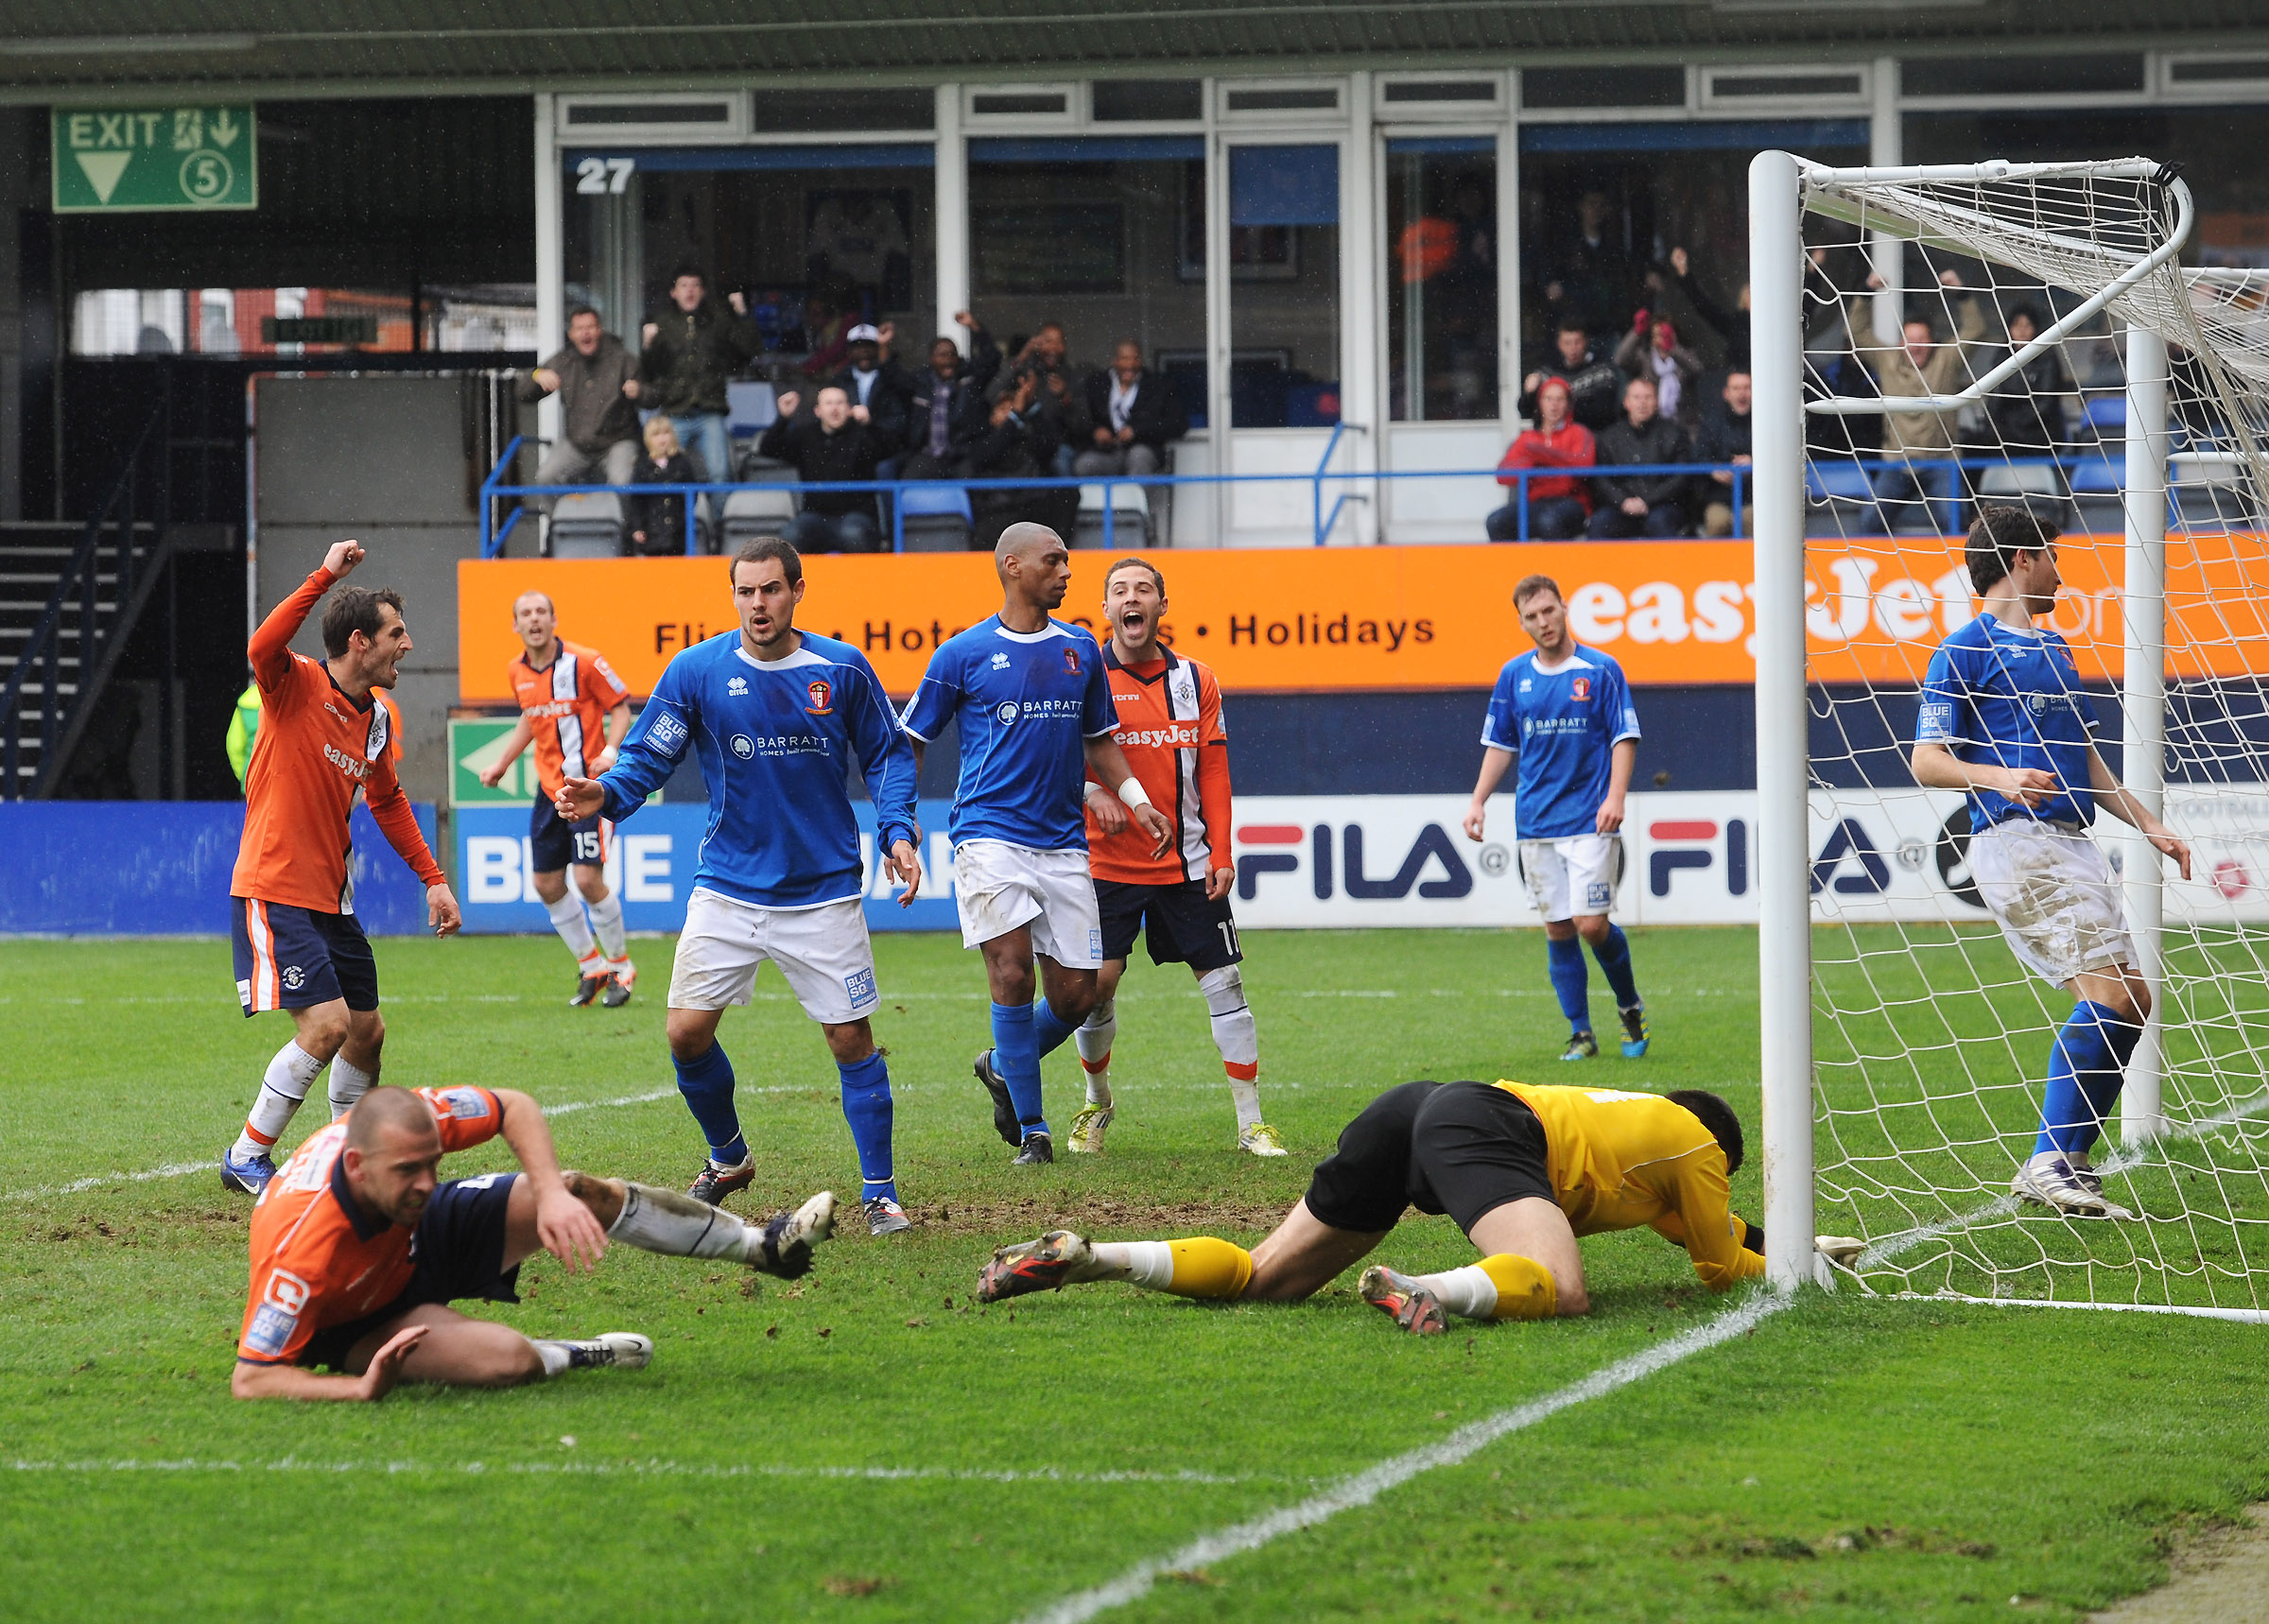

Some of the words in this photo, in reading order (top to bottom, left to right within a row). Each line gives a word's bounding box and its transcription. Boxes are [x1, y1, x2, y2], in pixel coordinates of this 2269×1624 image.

[69, 113, 162, 147] EXIT
[194, 159, 219, 195] 5
[576, 158, 635, 195] 27
[1229, 613, 1436, 653] Holidays
[1023, 700, 1083, 712] BARRATT
[652, 723, 673, 743] SQ
[658, 715, 688, 739] BLUE
[1113, 724, 1200, 748] easyJet
[756, 735, 829, 750] BARRATT
[574, 832, 600, 860] 15
[1650, 818, 1890, 897] FIA
[1238, 823, 1473, 899] FILA
[847, 969, 872, 988] BLUE
[850, 983, 868, 999] SQ
